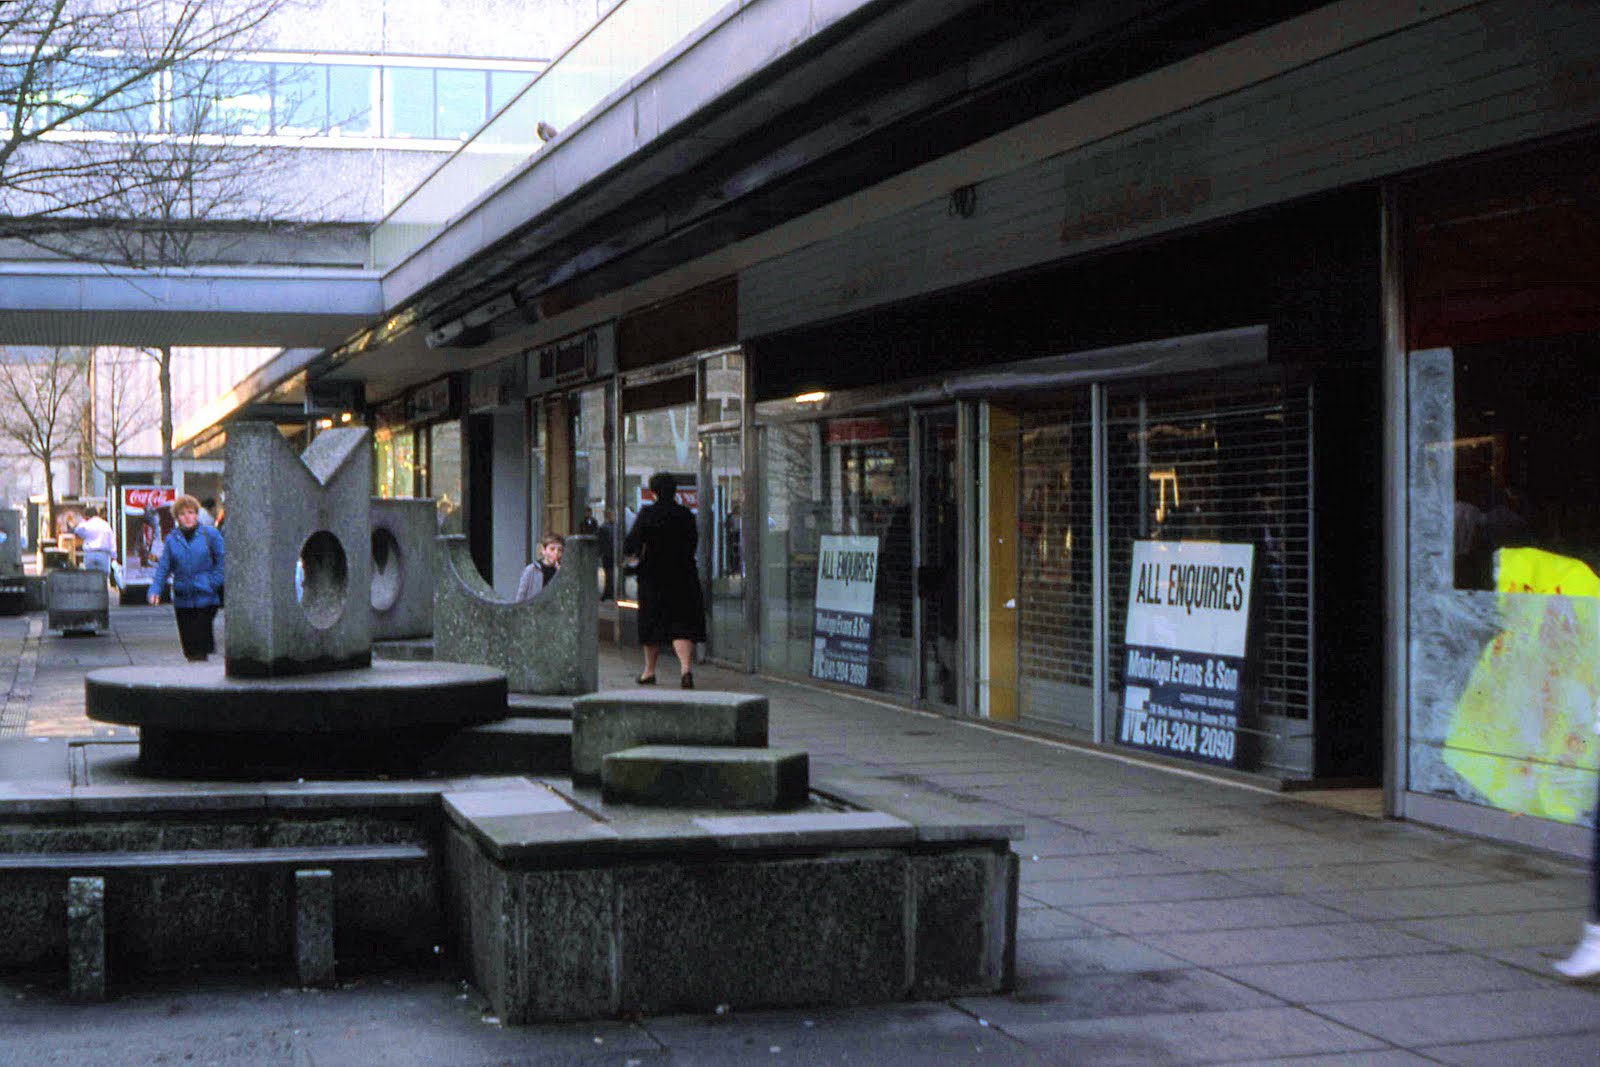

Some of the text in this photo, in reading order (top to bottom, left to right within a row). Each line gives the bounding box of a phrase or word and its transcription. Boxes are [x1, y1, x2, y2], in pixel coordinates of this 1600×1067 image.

[821, 550, 834, 580] ALL
[1136, 563, 1245, 615] ALL ENQUIRIES
[1171, 655, 1203, 687] Evans
[1204, 659, 1214, 688] &
[1215, 660, 1239, 691] Son
[1199, 727, 1235, 761] 2090
